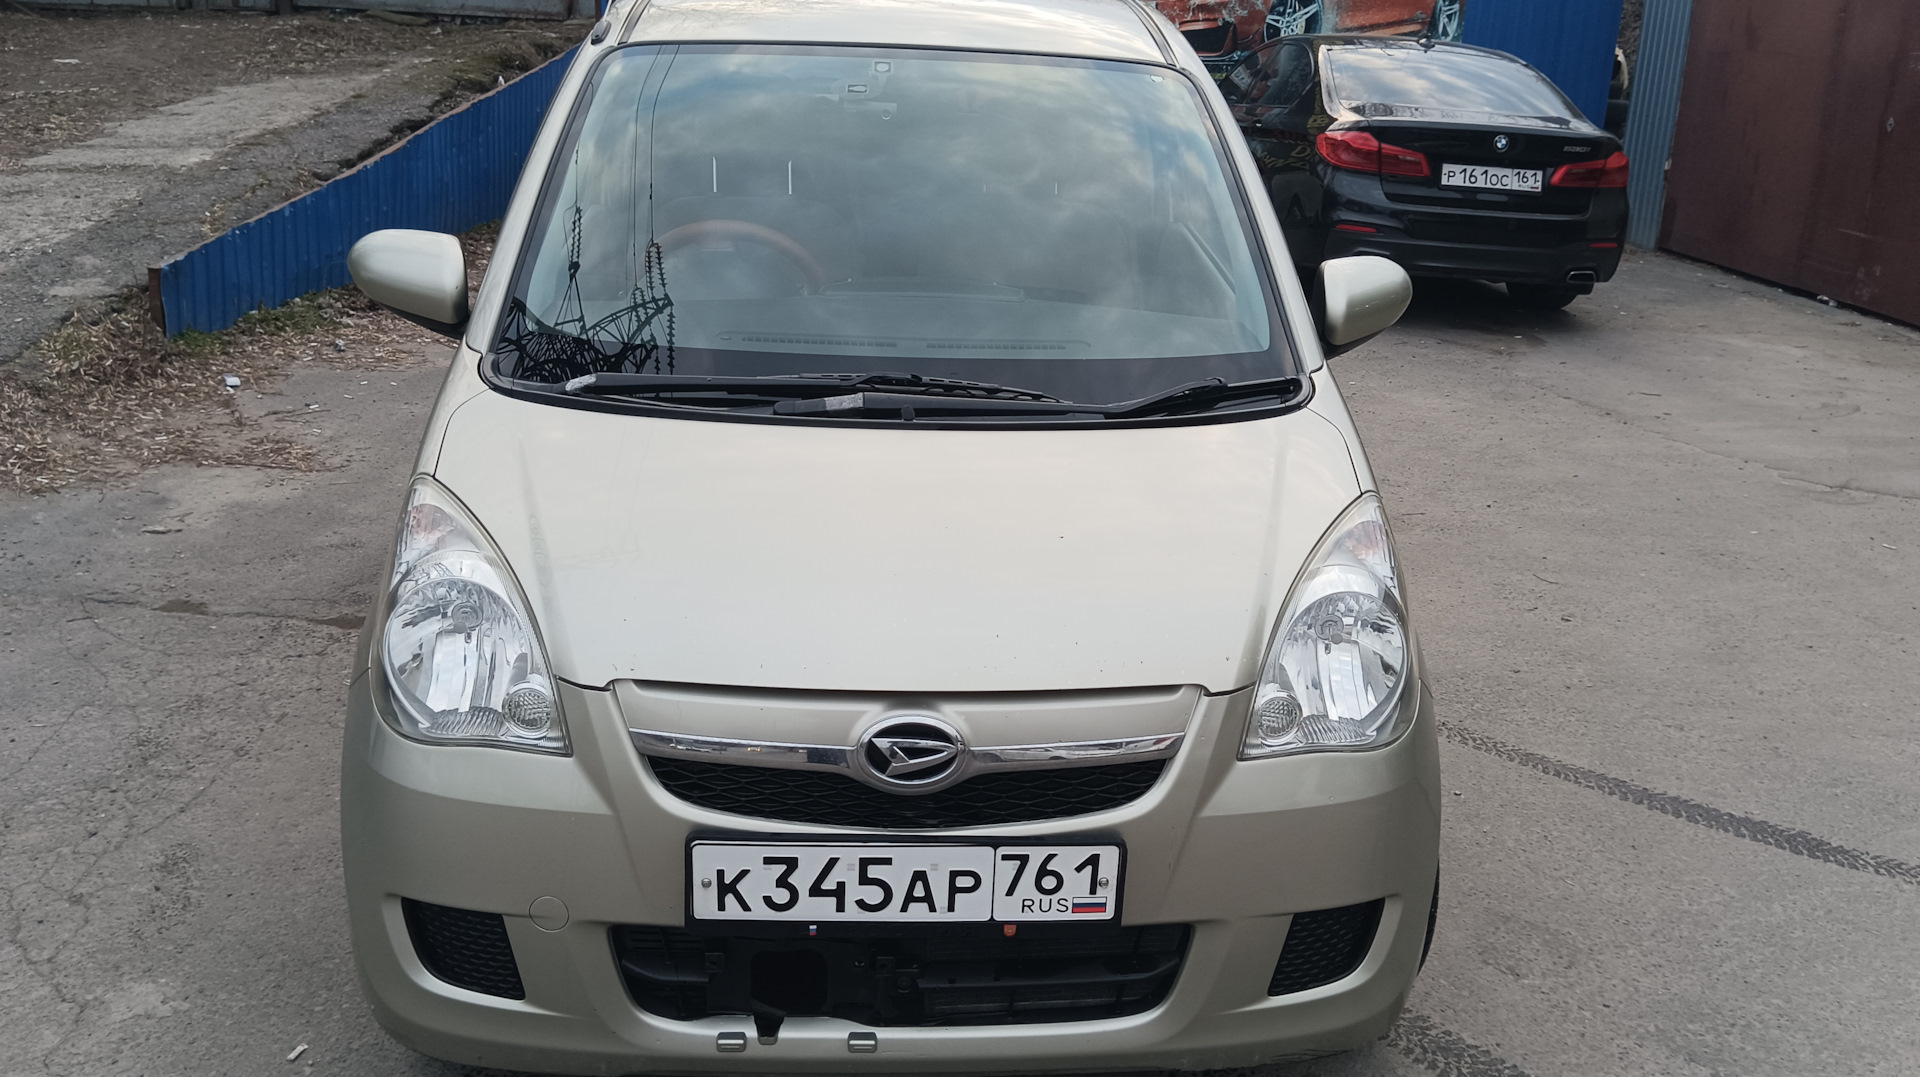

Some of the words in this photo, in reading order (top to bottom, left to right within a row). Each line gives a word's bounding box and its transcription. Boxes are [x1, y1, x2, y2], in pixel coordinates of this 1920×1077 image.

[1514, 171, 1537, 185] 161
[716, 856, 982, 913] К345АР
[1000, 853, 1101, 897] 761
[1021, 898, 1069, 913] RUS
